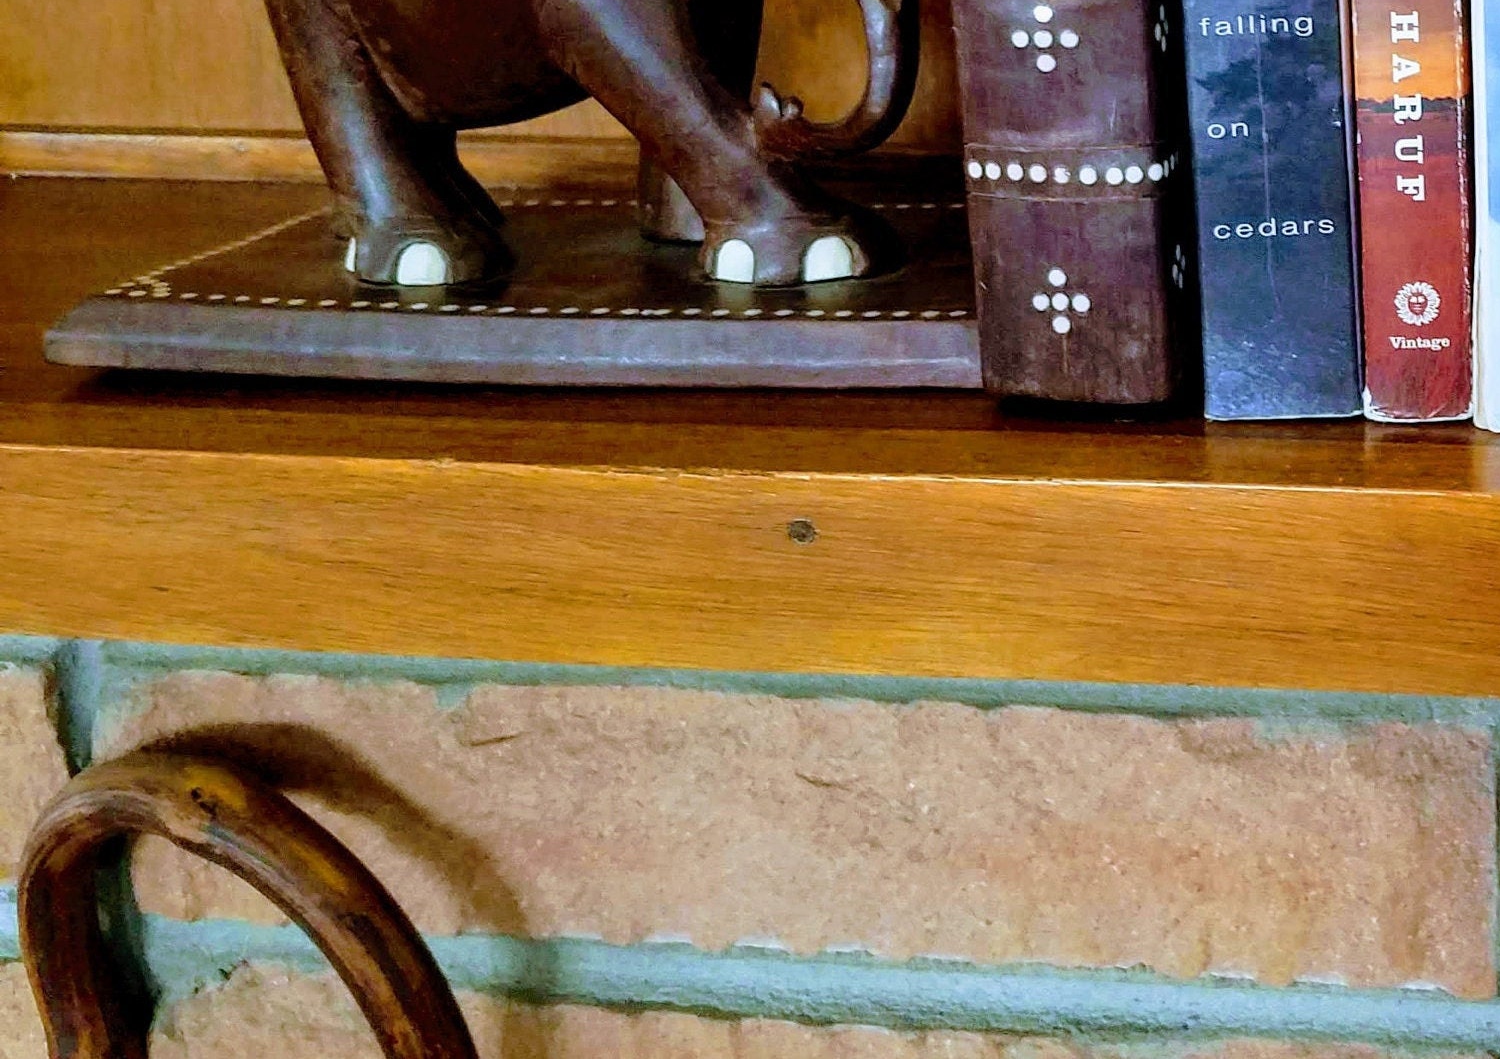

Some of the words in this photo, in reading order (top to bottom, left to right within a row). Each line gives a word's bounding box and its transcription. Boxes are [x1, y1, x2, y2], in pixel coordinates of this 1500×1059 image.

[1199, 13, 1314, 37] falling
[1390, 11, 1425, 201] HARUF
[1207, 121, 1249, 140] on
[1213, 217, 1335, 240] cedars
[1389, 336, 1451, 350] Vintage
